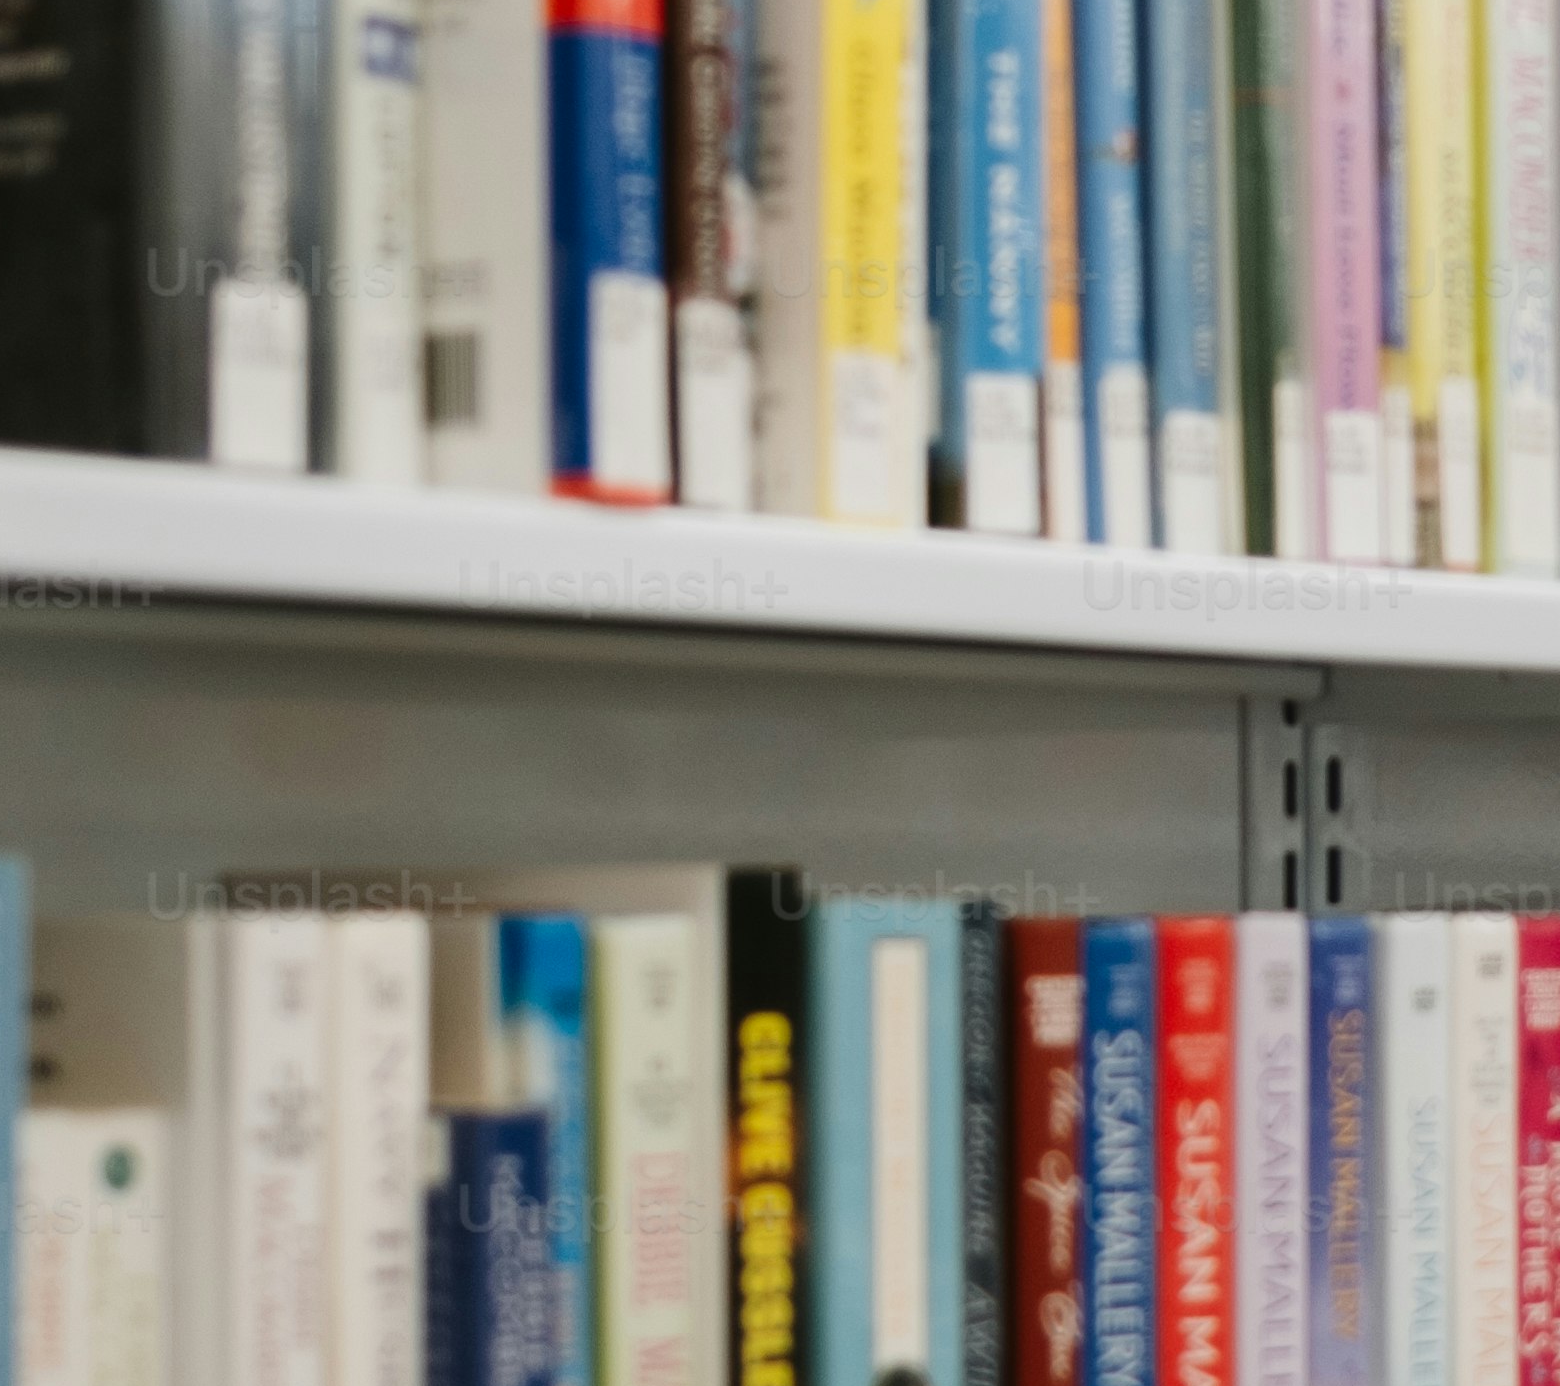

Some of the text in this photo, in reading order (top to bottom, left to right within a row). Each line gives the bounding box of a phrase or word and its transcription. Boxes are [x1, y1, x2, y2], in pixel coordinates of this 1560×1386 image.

[739, 1011, 793, 1175] CLIVE
[1093, 1029, 1144, 1185] SUSAN
[1328, 1009, 1365, 1340] SUSAN MALLERY
[1175, 1098, 1222, 1303] SUSAN
